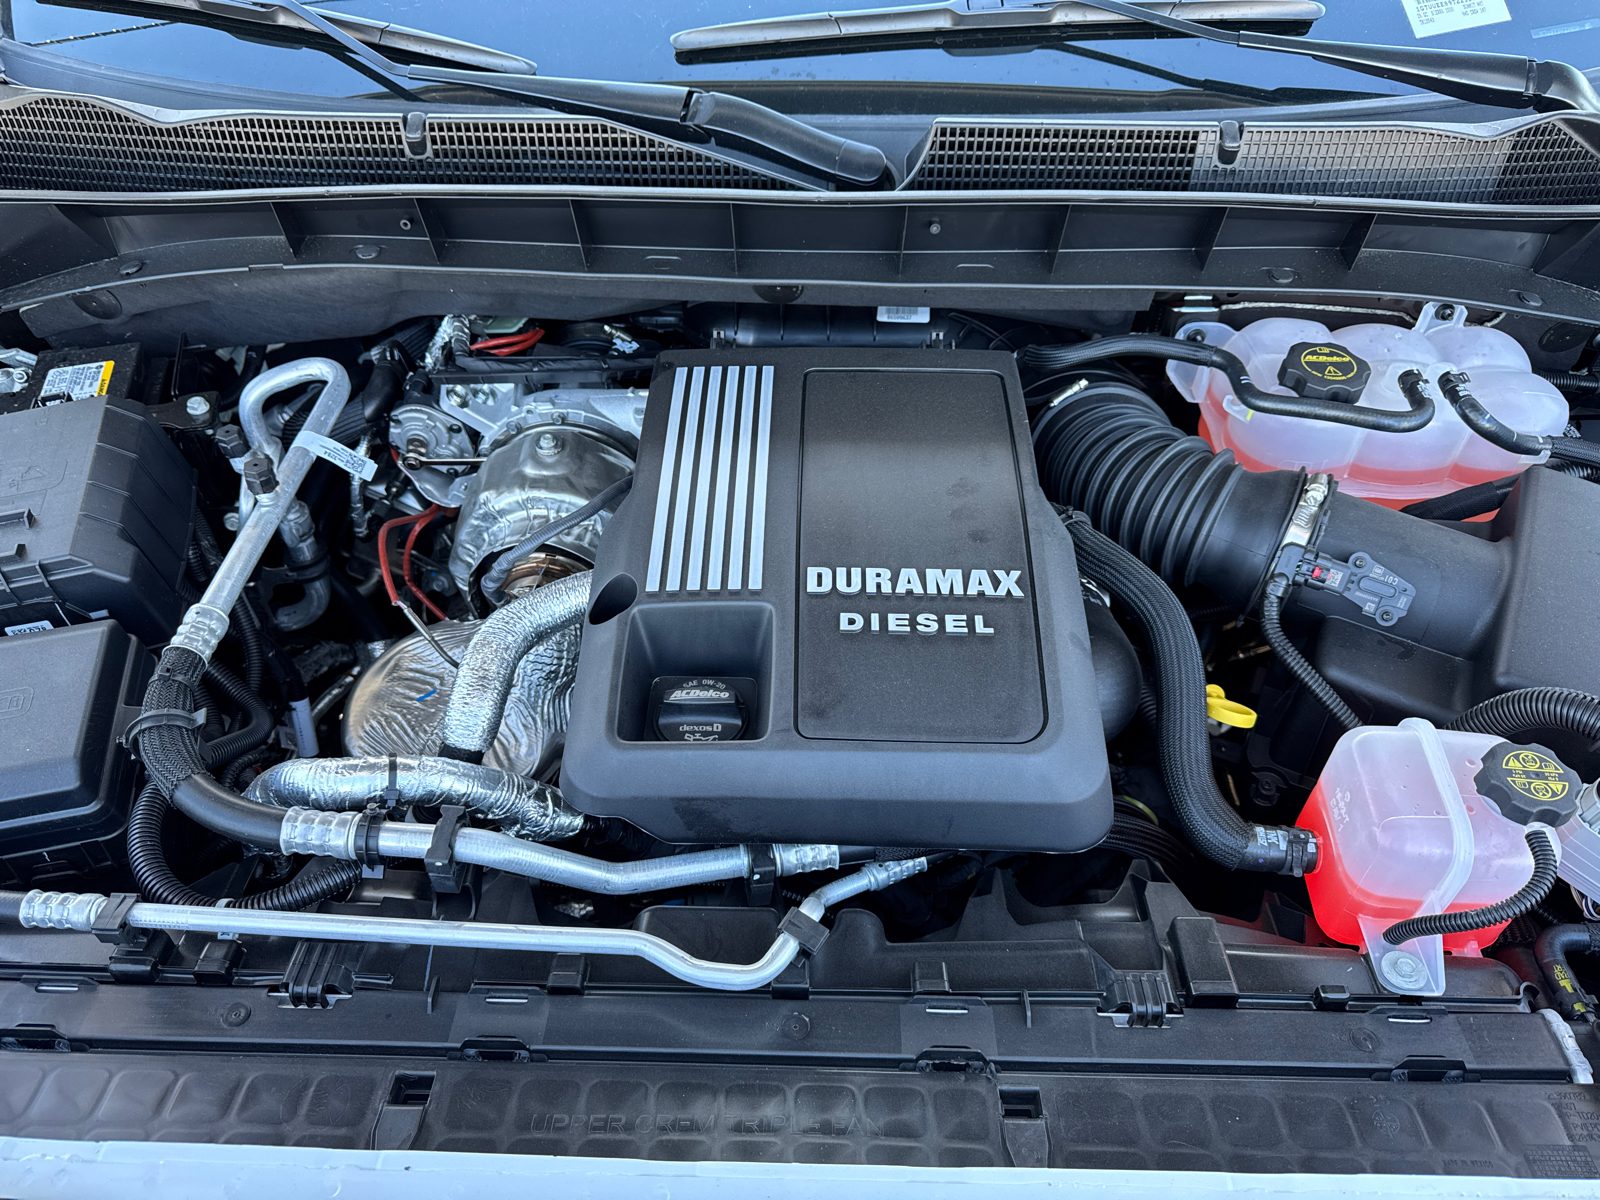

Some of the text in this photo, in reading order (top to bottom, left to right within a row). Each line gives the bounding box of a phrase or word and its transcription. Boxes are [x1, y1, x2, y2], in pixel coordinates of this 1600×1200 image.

[806, 566, 1025, 597] DURAMAX
[838, 612, 995, 636] DIESEL
[670, 689, 730, 699] ACDelco
[682, 679, 727, 690] SAE 0W-20
[530, 1113, 627, 1137] UPPER
[724, 1114, 823, 1136] TRIPLE
[831, 1114, 885, 1138] FAN
